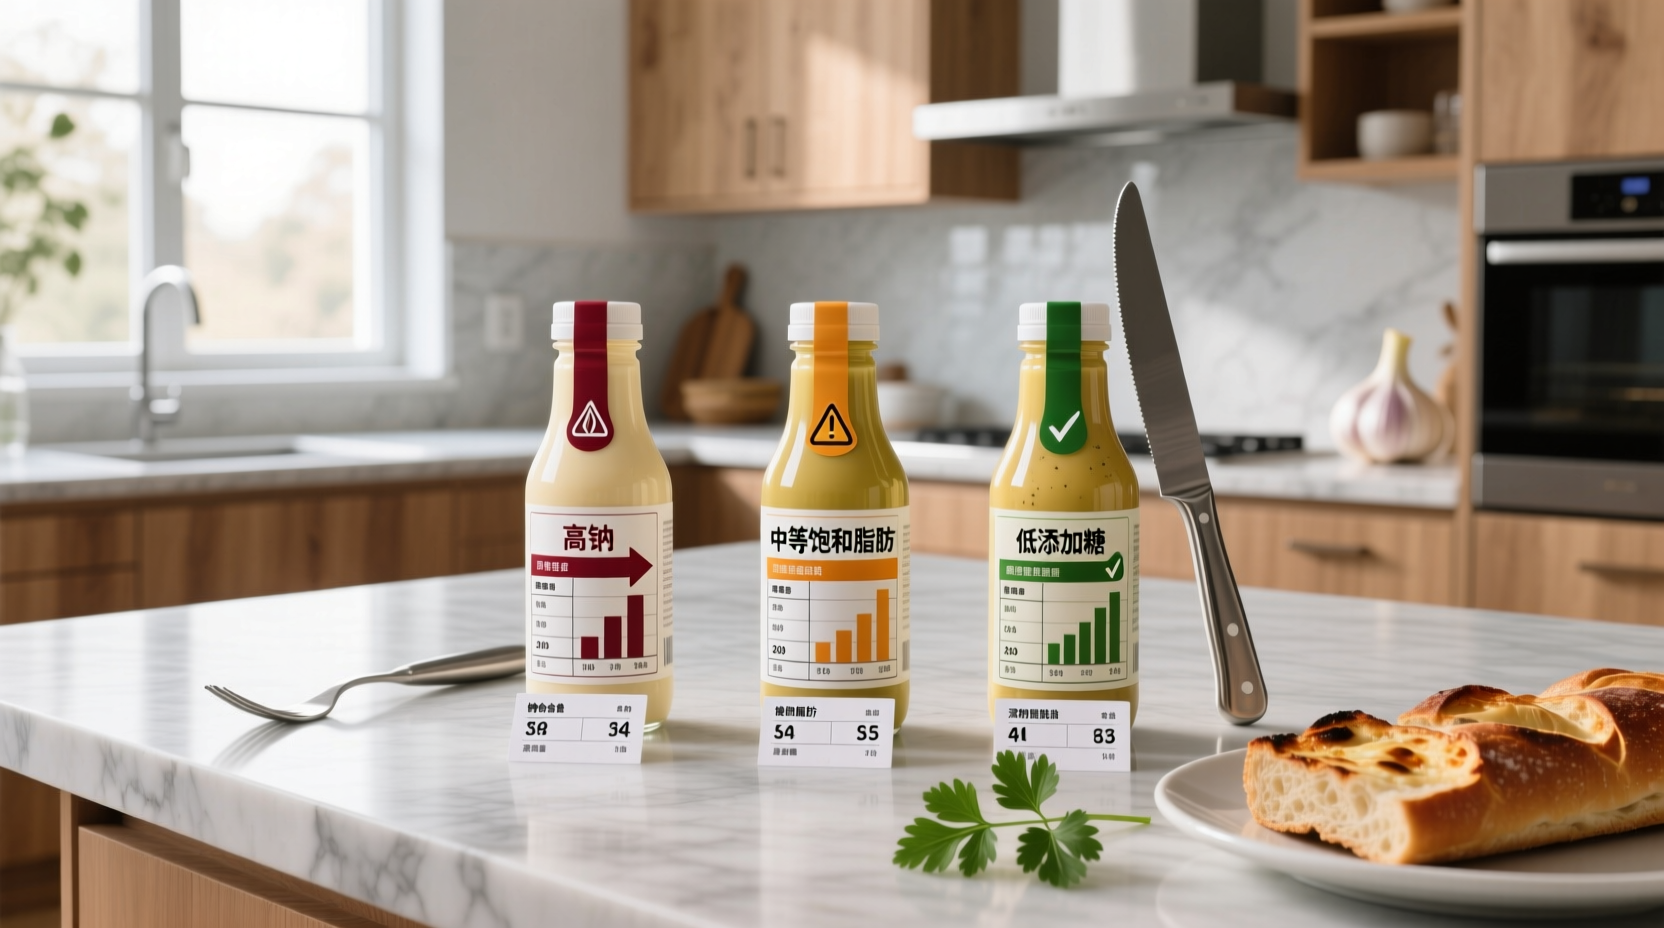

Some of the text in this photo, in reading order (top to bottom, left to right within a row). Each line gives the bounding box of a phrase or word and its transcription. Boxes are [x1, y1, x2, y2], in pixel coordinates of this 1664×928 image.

[563, 523, 614, 552] 高钠
[770, 525, 896, 554] 中等饱和脂肪
[1016, 528, 1106, 555] 低添加糖
